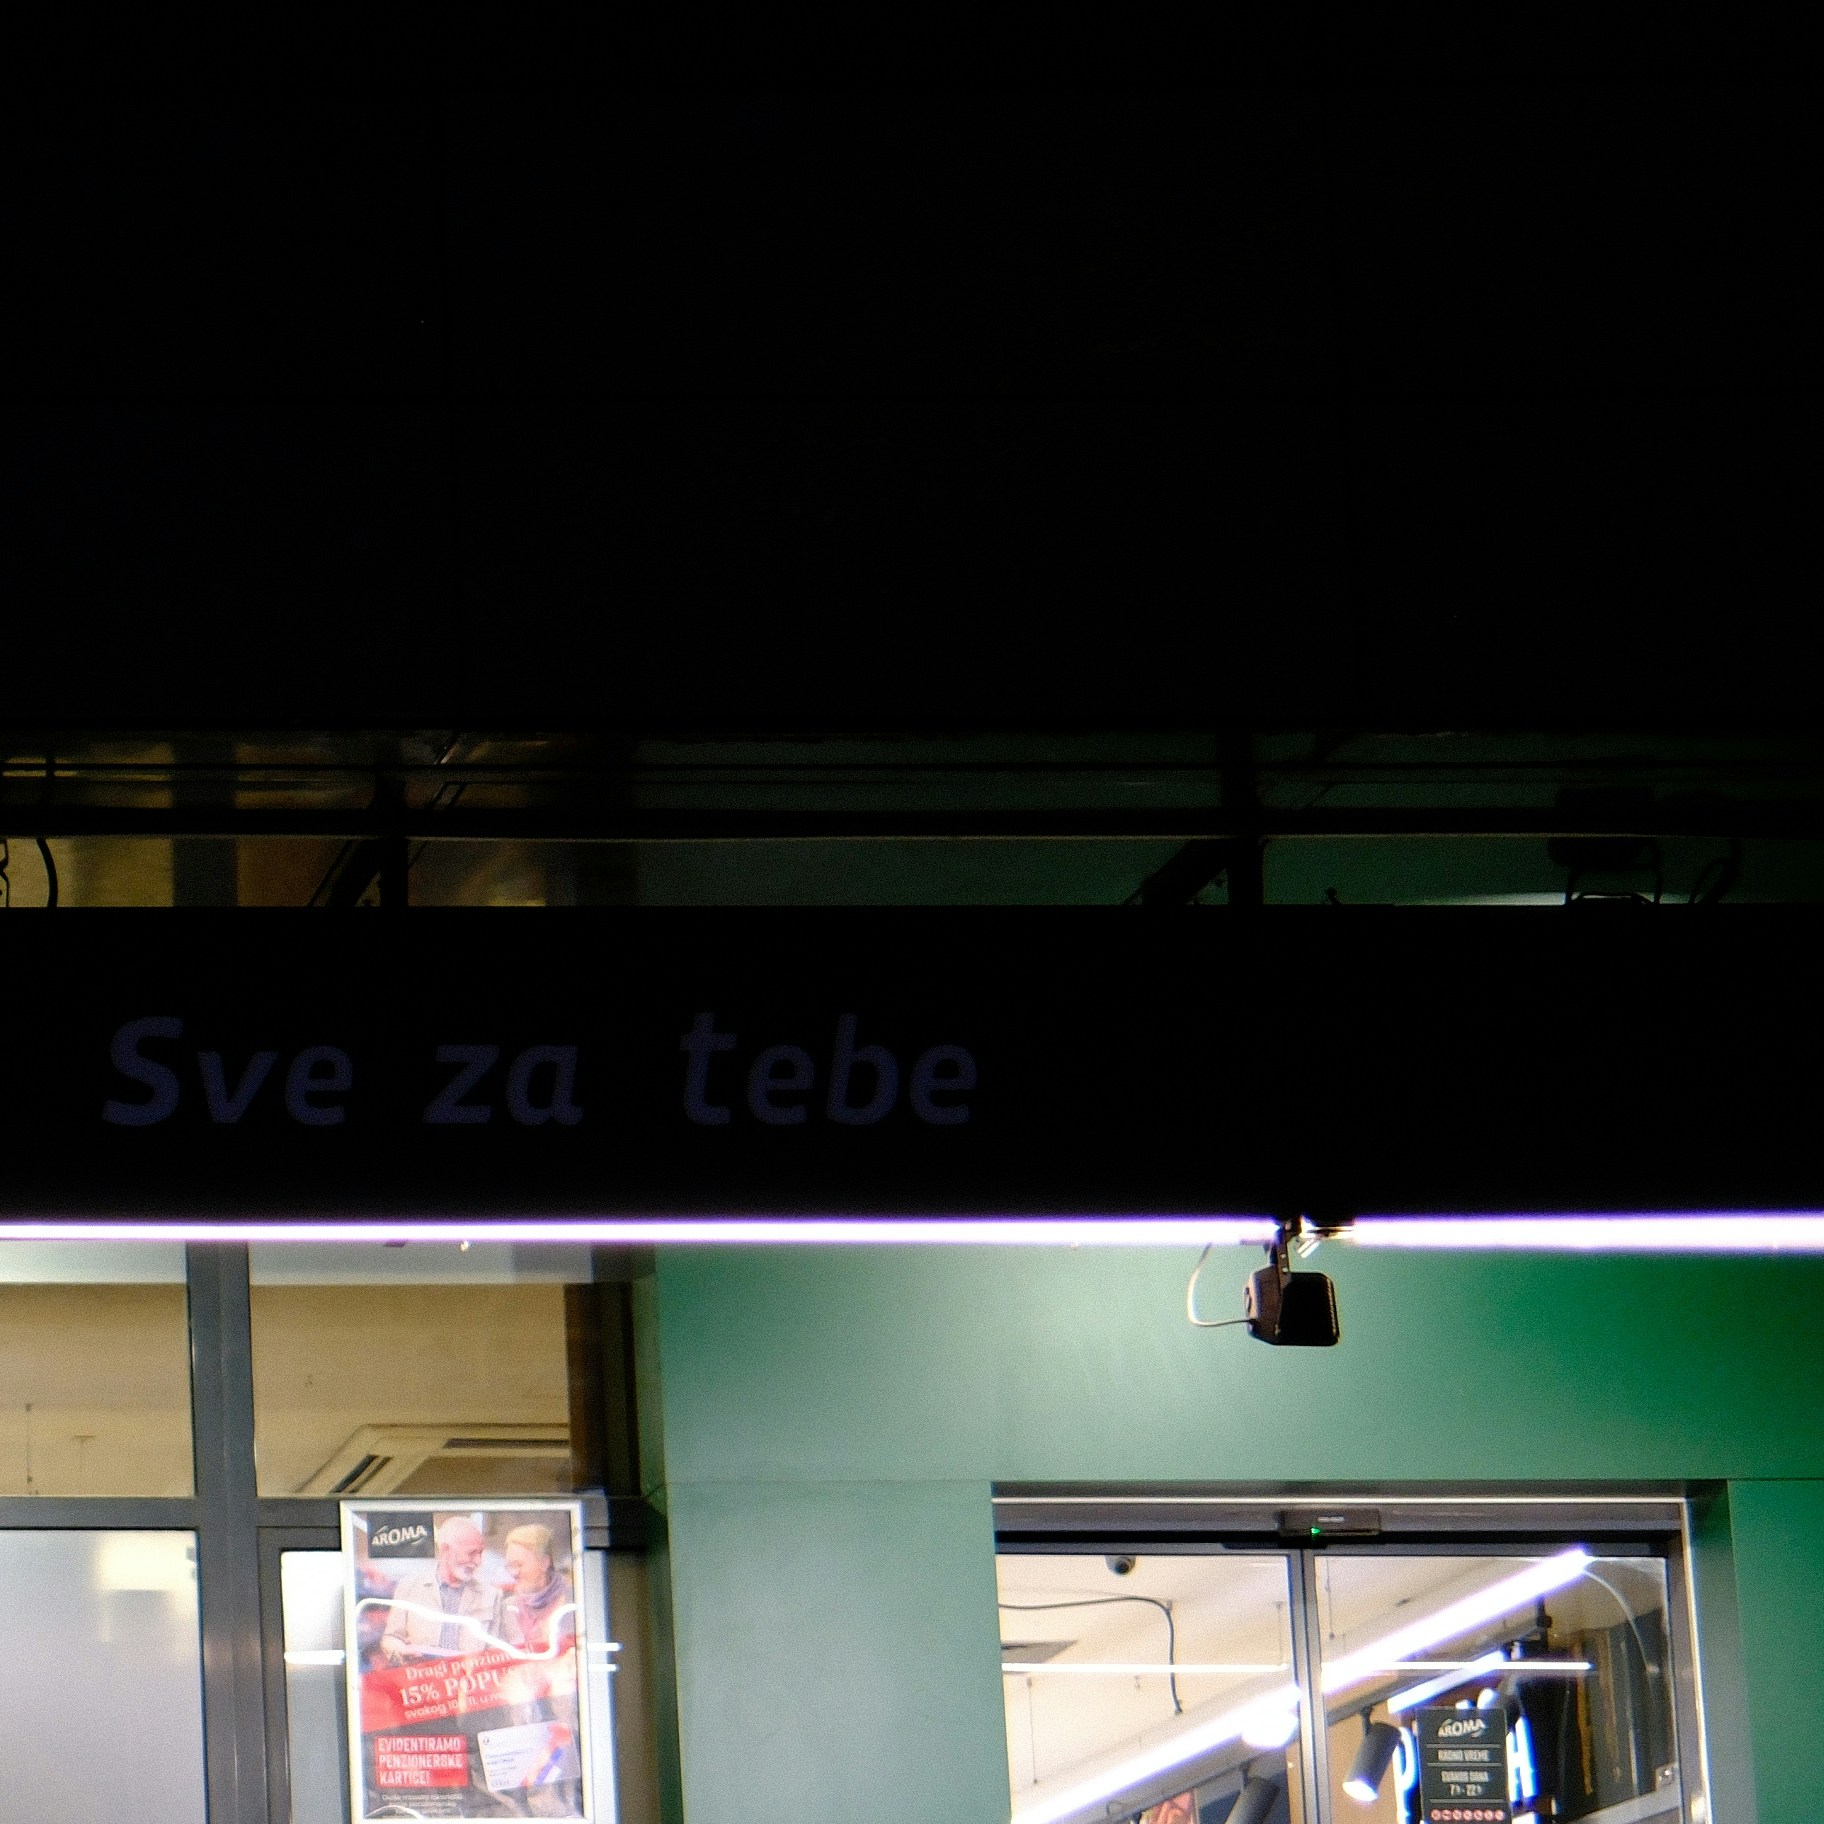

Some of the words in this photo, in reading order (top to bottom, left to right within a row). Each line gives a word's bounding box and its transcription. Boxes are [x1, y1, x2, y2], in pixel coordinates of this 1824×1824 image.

[102, 1014, 355, 1127] Sve
[423, 1042, 585, 1127] za
[681, 1011, 981, 1127] tebe
[371, 1525, 428, 1546] AROMA
[406, 1661, 447, 1682] Dragi
[400, 1682, 440, 1706] 15%
[1438, 1718, 1486, 1737] AROMA
[378, 1737, 461, 1753] EVIDENTIRAMO
[379, 1753, 463, 1769] PENZIONERSKE
